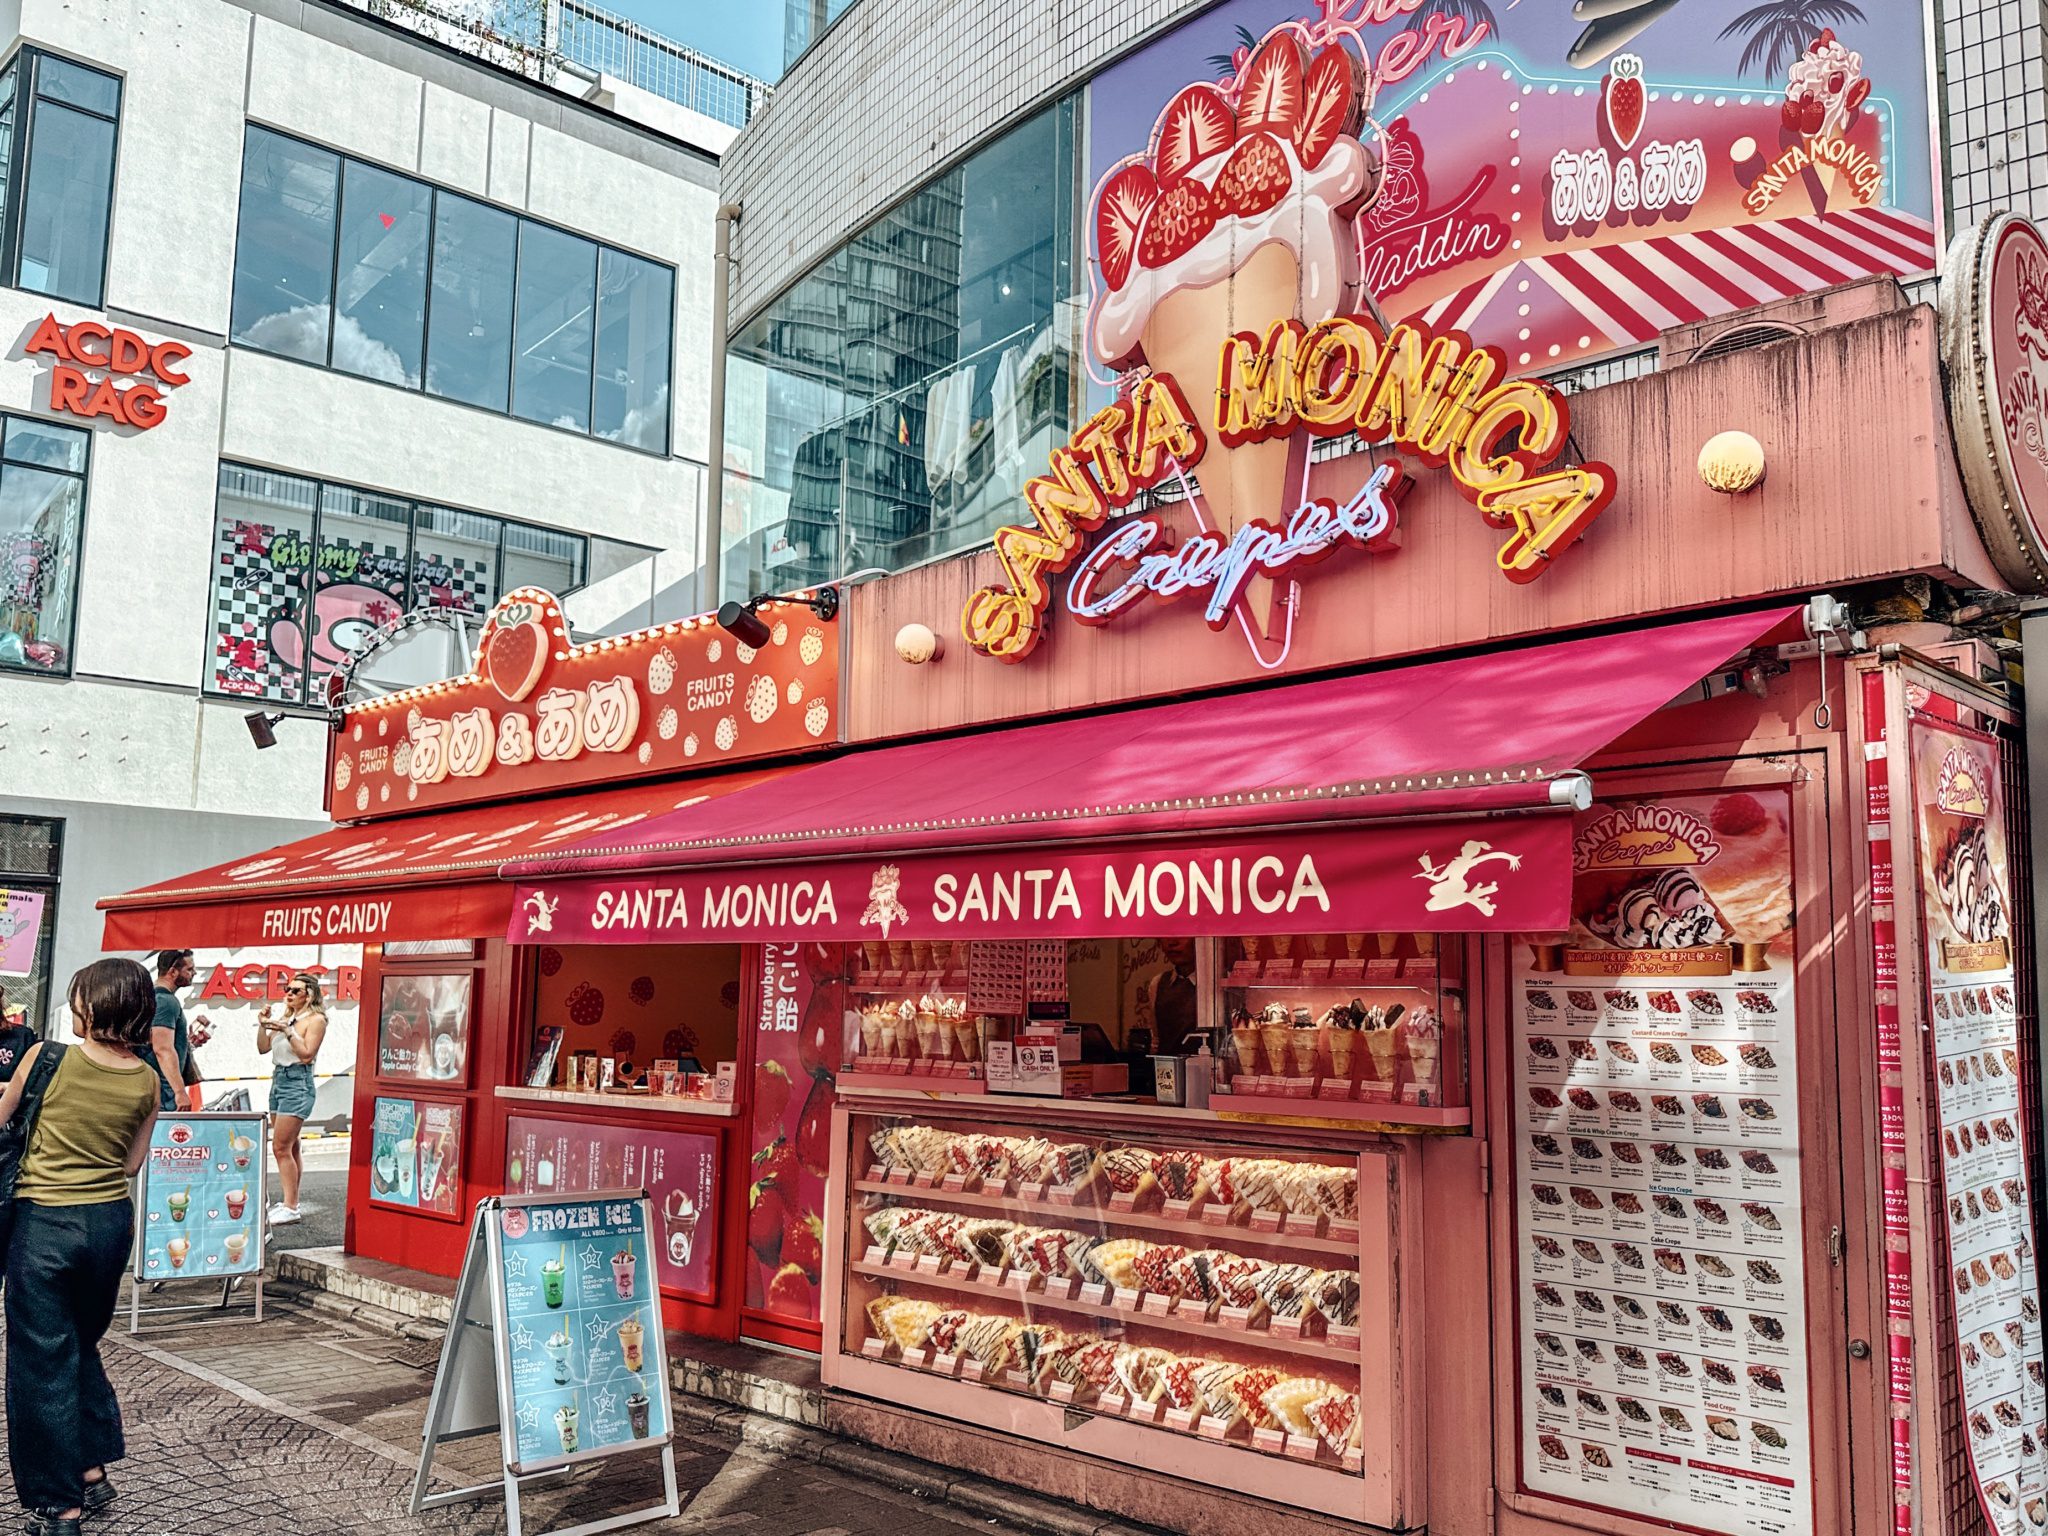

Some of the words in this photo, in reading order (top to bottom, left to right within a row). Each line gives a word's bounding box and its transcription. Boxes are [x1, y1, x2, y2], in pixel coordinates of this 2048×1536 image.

[1747, 145, 1810, 212] SANTA
[1810, 137, 1883, 202] MONICA
[1366, 218, 1500, 297] laddin
[25, 312, 193, 385] ACDC
[51, 366, 167, 429] RAG
[2004, 370, 2041, 441] SANTA
[962, 375, 1205, 662] SANTA
[1213, 314, 1616, 582] MONICA
[1066, 462, 1398, 627] Crepes
[222, 681, 242, 690] ACDC
[243, 683, 260, 691] RAG
[687, 672, 735, 697] FRUITS
[687, 688, 735, 712] CANDY
[359, 746, 389, 762] FRUITS
[359, 758, 388, 775] CANDY
[1575, 812, 1632, 868] SANTA
[1635, 808, 1719, 863] MONICA
[1600, 838, 1675, 864] Crepes
[932, 867, 1082, 922] SANTA
[1103, 853, 1331, 919] MONICA
[592, 888, 688, 930] SANTA
[701, 880, 837, 929] MONICA
[262, 907, 323, 938] FRUITS
[326, 901, 392, 936] CANDY
[1604, 963, 1683, 973] オリジナルクレープ
[760, 943, 778, 1031] Strawberry
[150, 1146, 211, 1161] FROZEN
[532, 1206, 600, 1232] FROZEN
[605, 1204, 632, 1226] ICE
[1886, 1214, 1909, 1223] ¥600
[1889, 1283, 1911, 1291] ストロ
[1892, 1382, 1911, 1391] ¥62
[1719, 1403, 1736, 1412] Crepe
